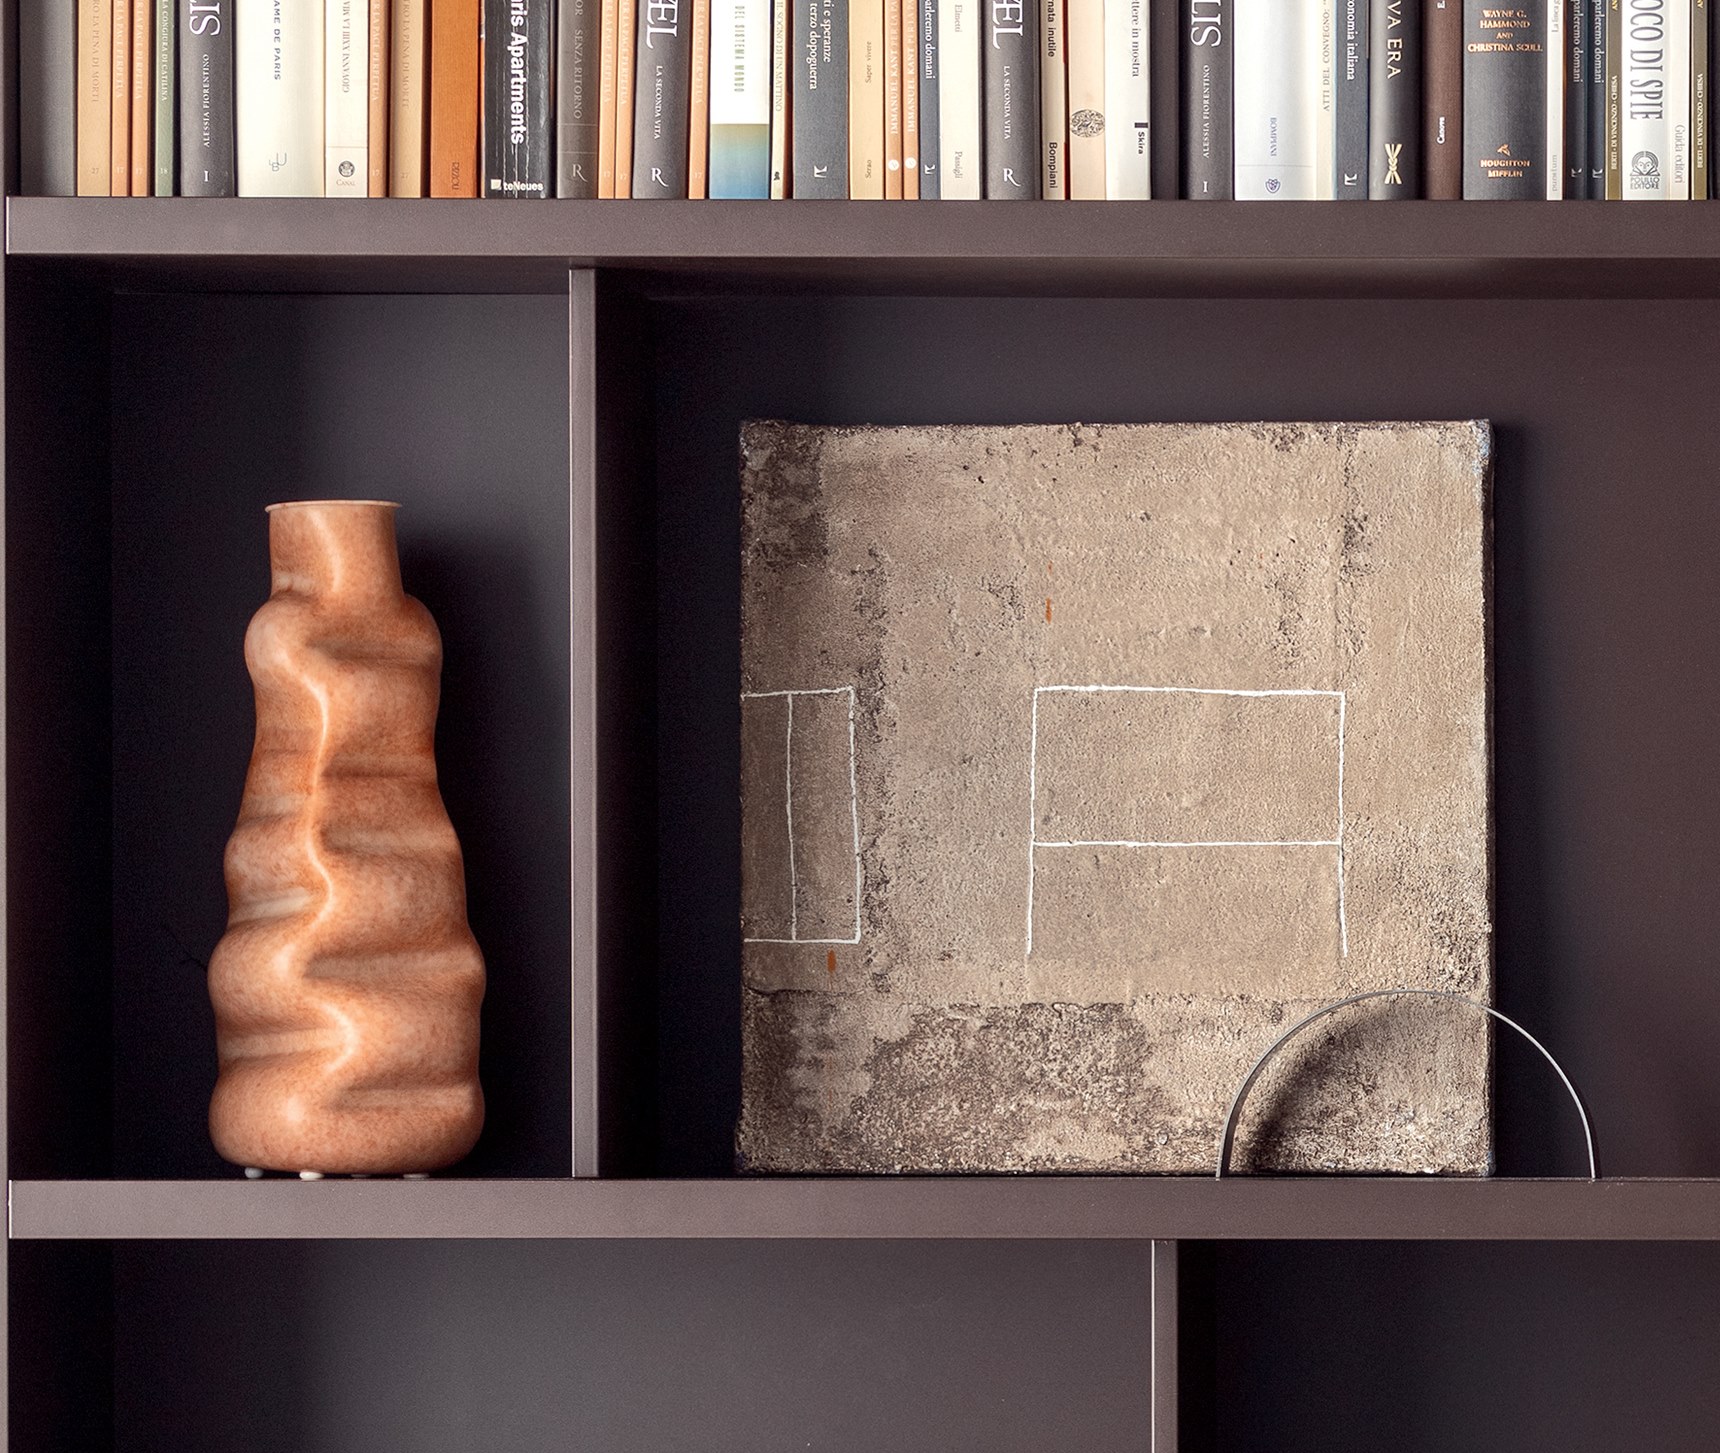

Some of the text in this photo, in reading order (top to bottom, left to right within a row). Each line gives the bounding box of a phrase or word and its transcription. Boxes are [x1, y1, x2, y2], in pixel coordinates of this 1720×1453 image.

[1479, 19, 1530, 29] HAMMOND
[1482, 9, 1513, 18] WAYNE
[821, 18, 831, 63] speranze
[1467, 43, 1514, 52] CHRISTINA
[1496, 32, 1513, 40] AND
[273, 48, 281, 80] PARIS
[574, 29, 583, 119] SENZA RITORNO
[806, 31, 817, 90] dopoguerra
[925, 43, 935, 79] domani
[1346, 43, 1358, 80] italiana
[1387, 38, 1402, 79] ERA
[507, 32, 528, 145] Apartments
[1630, 49, 1664, 120] DI SPIE
[1137, 131, 1145, 155] Skira
[1048, 142, 1058, 189] Bompiani
[1480, 159, 1530, 168] HOUGHTON
[1487, 169, 1523, 178] MIFFLIN
[503, 180, 544, 191] teNeues
